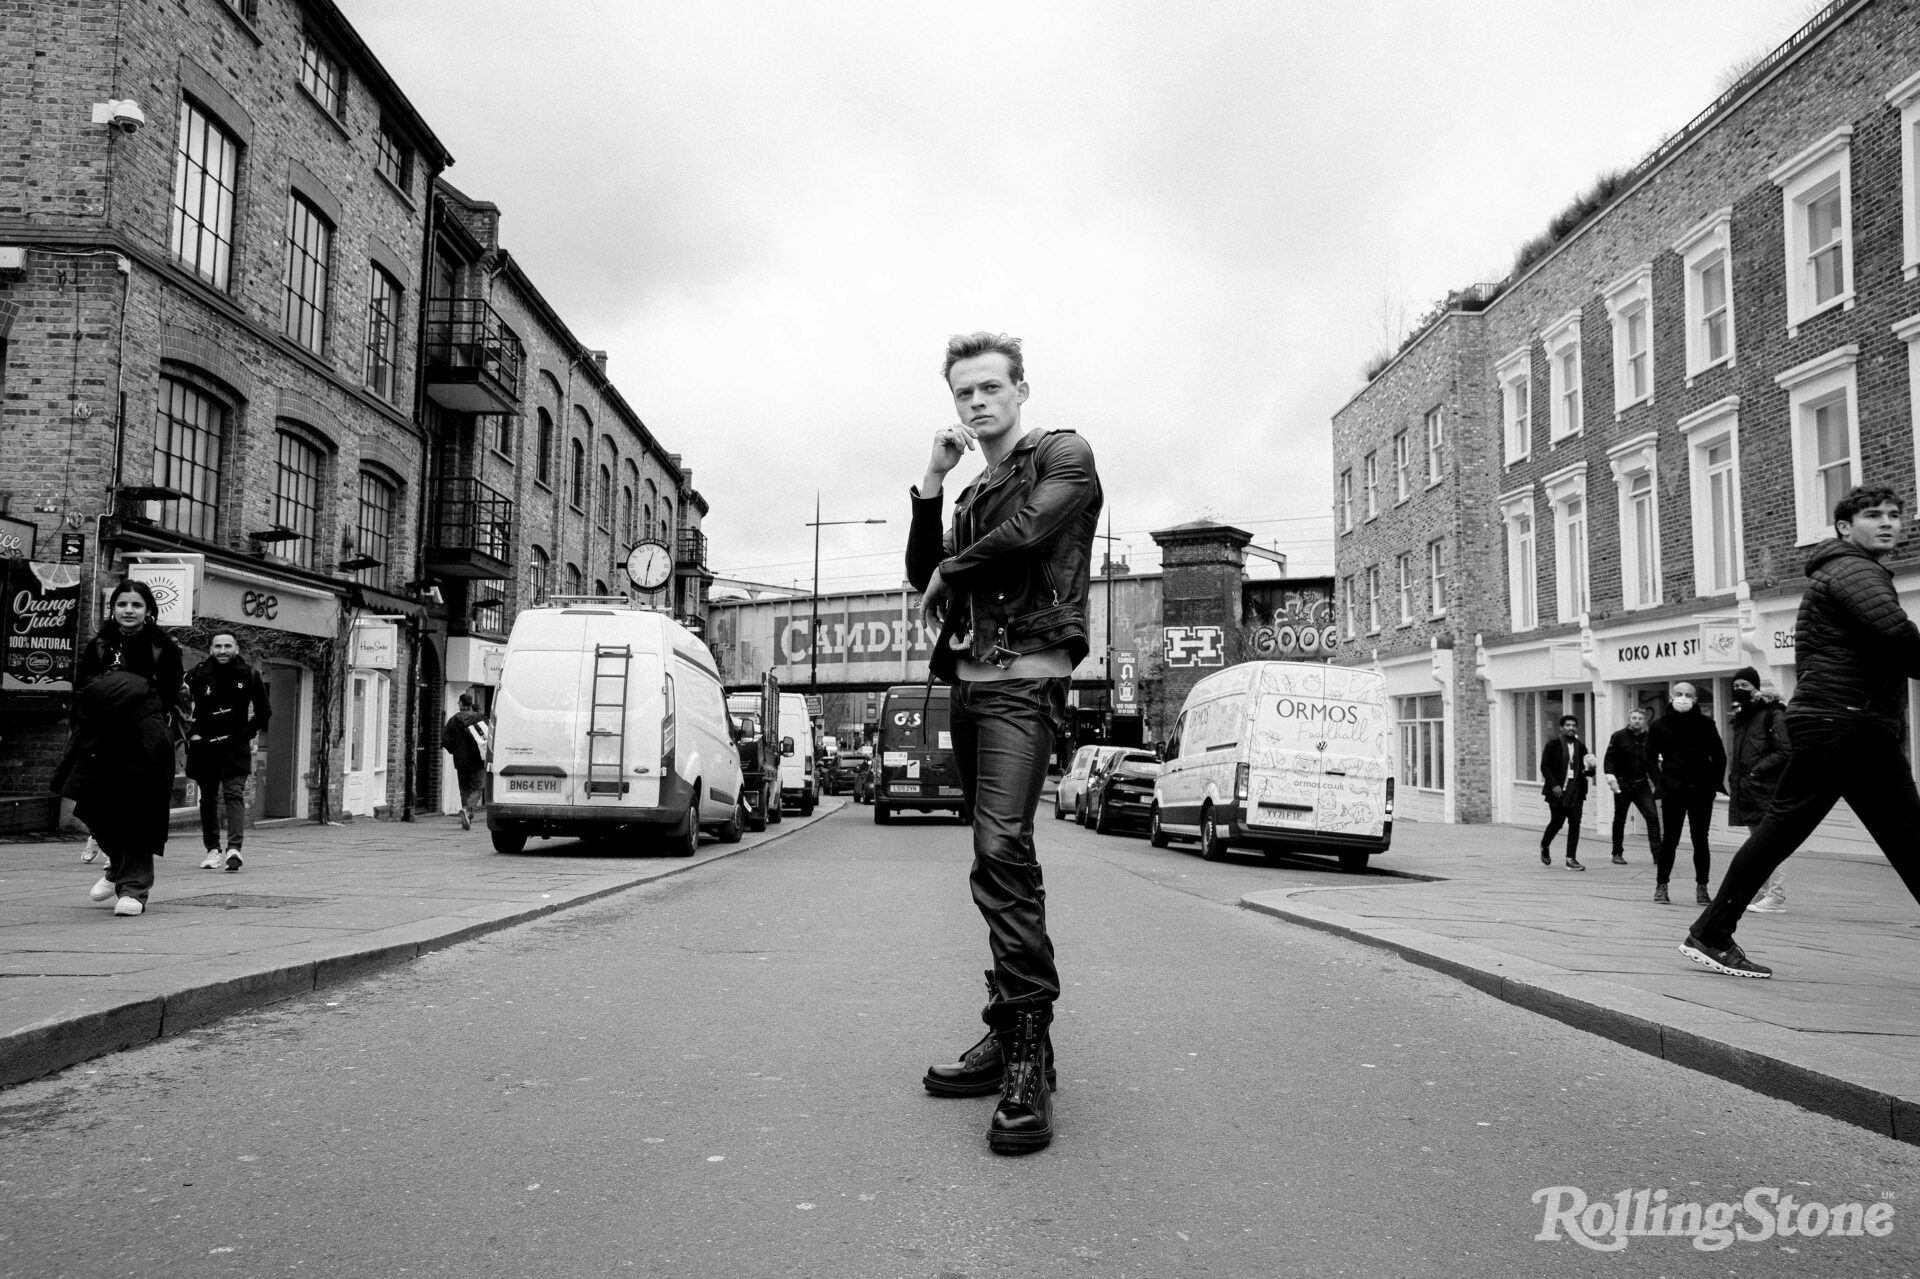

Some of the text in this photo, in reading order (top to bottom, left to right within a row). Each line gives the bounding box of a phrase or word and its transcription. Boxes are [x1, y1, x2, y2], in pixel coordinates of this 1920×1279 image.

[13, 590, 76, 616] Orange
[13, 612, 66, 634] Juice
[9, 636, 72, 650] 100% NATURAL
[781, 619, 942, 662] CAMDEN
[1618, 645, 1649, 662] KOKO
[1656, 641, 1677, 658] ART
[1684, 637, 1700, 655] ST
[894, 711, 921, 728] G4S
[1276, 698, 1358, 725] ORMOS
[510, 780, 556, 791] BN64 EVH
[1293, 781, 1345, 791] ormos.co.uk
